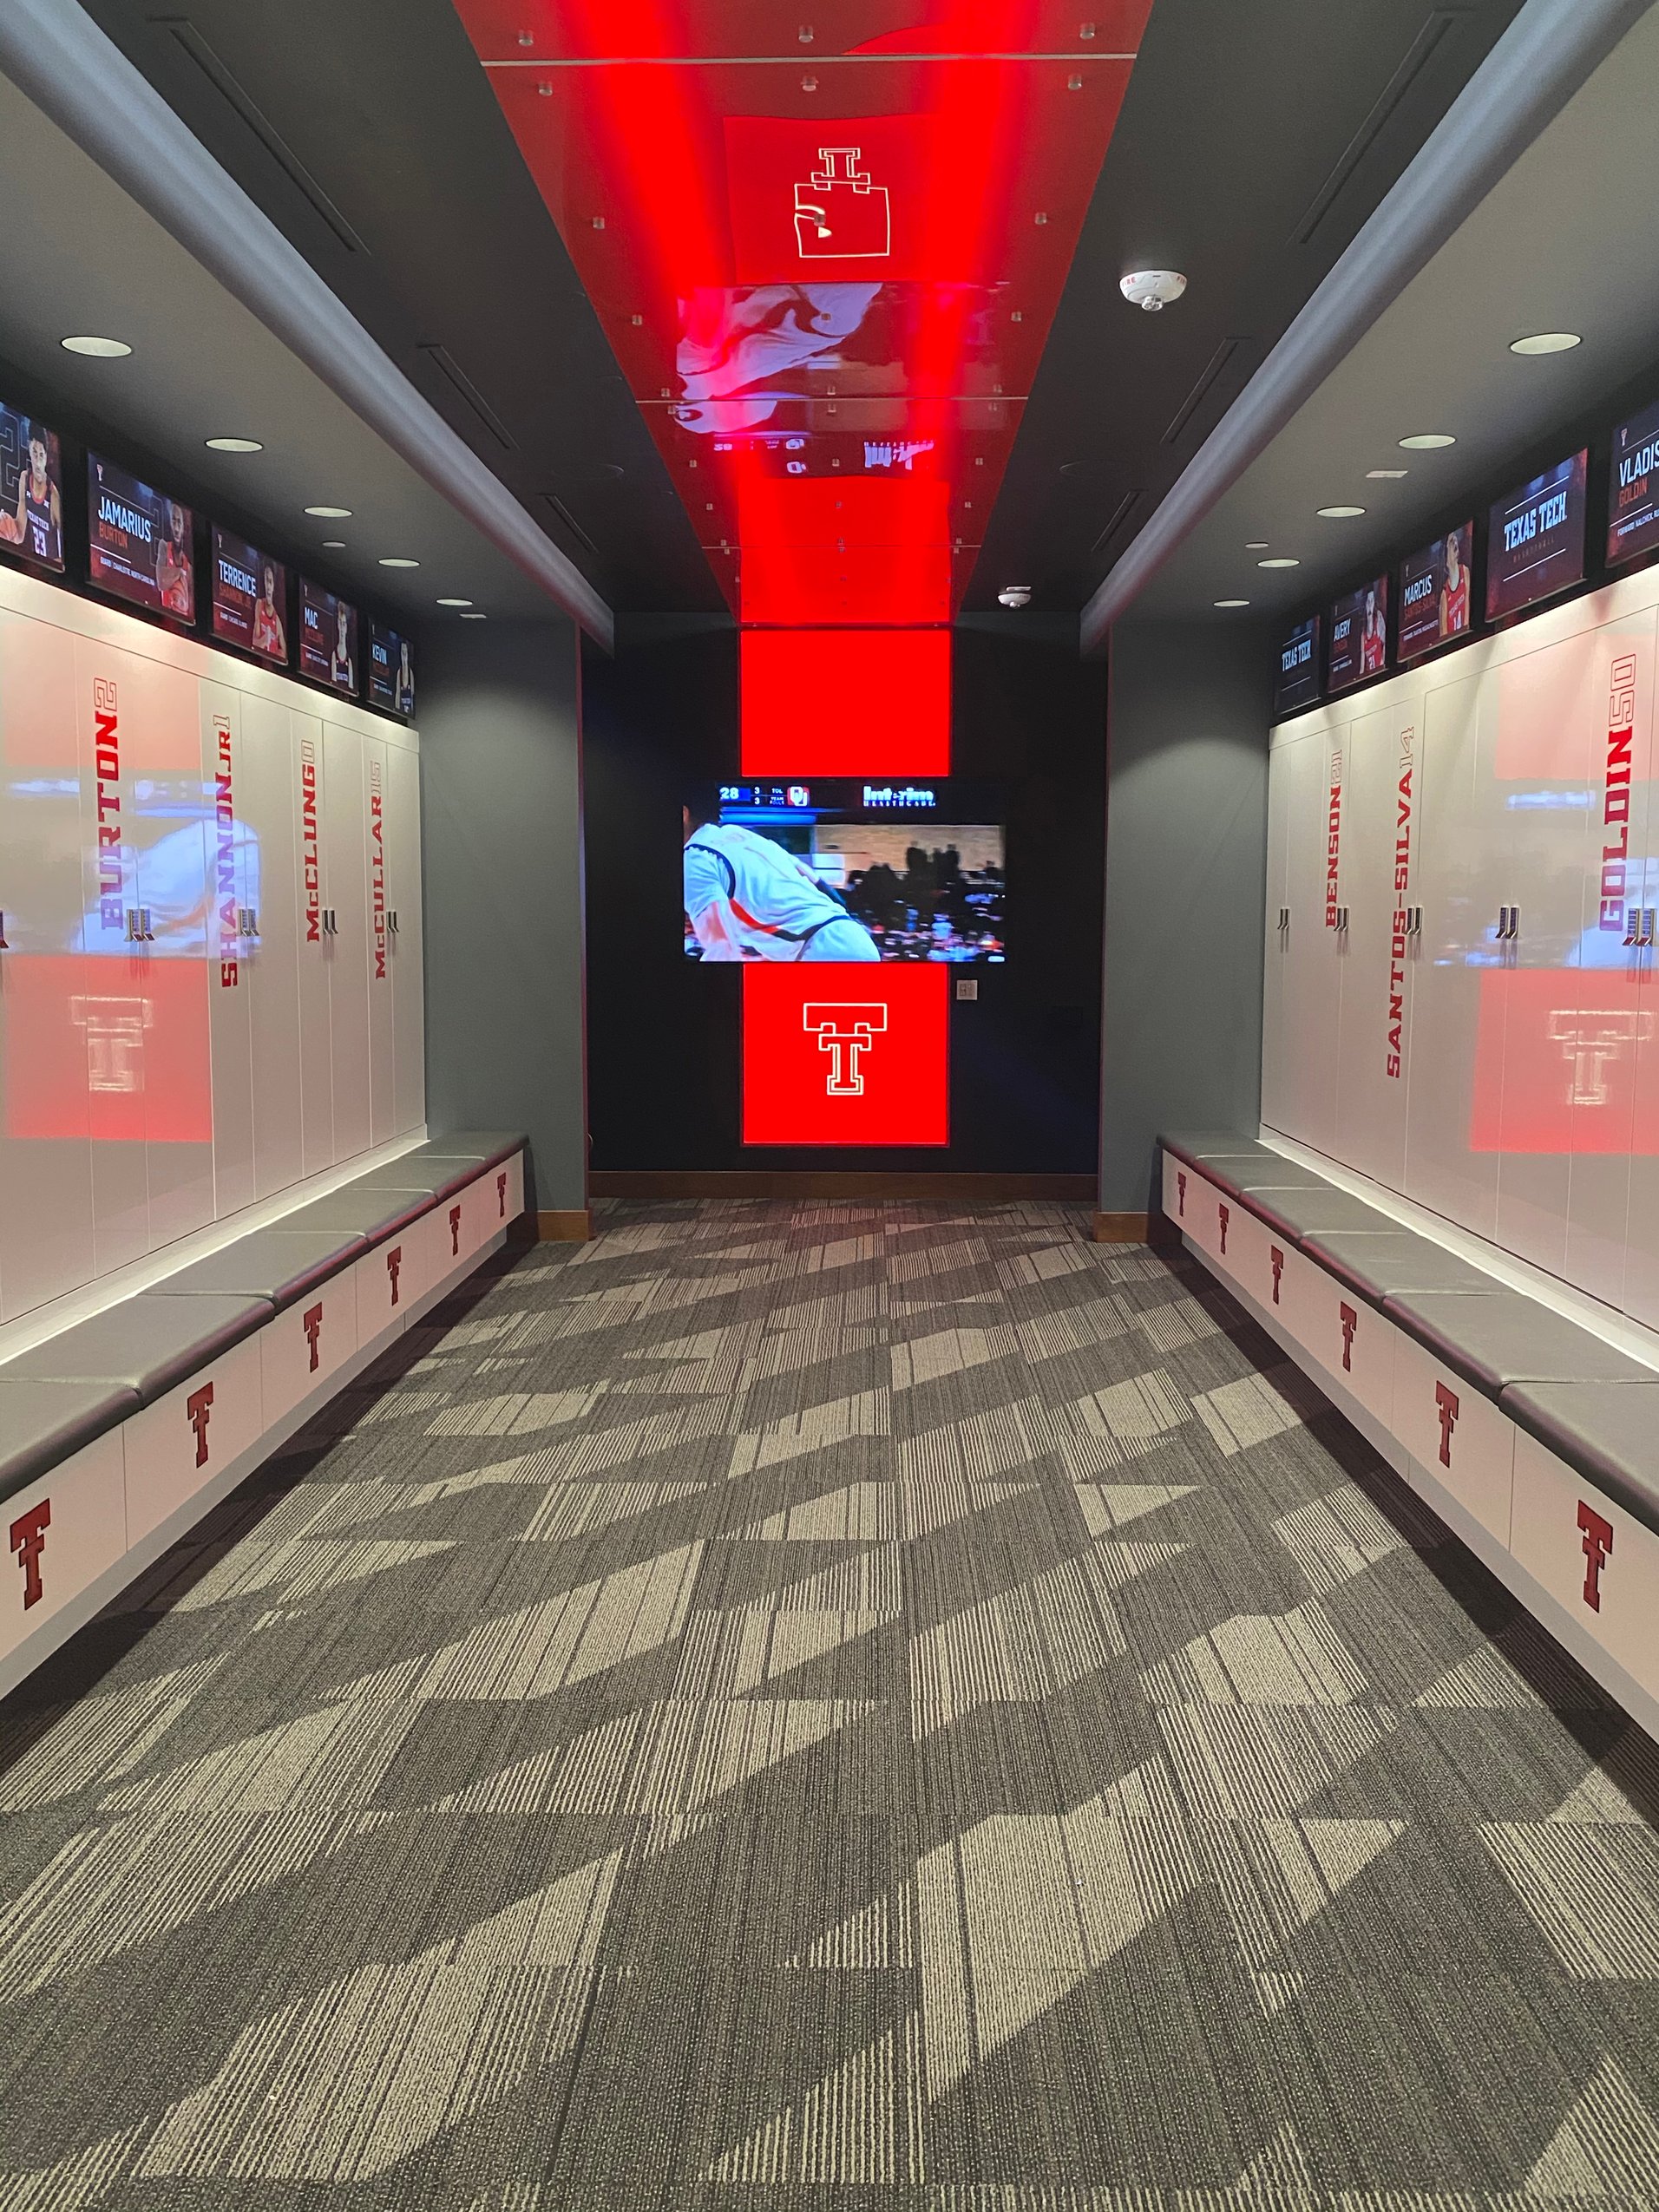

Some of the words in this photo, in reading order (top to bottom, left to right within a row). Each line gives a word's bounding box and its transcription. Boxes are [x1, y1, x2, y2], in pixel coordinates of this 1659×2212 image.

[1618, 477, 1649, 507] GOLDIN
[98, 495, 154, 543] JAMARIUS
[99, 521, 129, 549] BURTON
[1504, 507, 1537, 552] TEXAS
[1538, 490, 1568, 533] TECH
[219, 560, 257, 598] TERRENCE
[1404, 574, 1433, 606] MARCUS
[305, 607, 318, 630] MAC
[1334, 618, 1351, 642] AVERY
[372, 643, 388, 666] KEVIN
[1282, 646, 1298, 672] TEXAS
[720, 787, 739, 800] 28
[95, 710, 123, 930] BURTON
[1599, 725, 1633, 932] GOLDIN
[1325, 785, 1341, 928] BENSON
[1387, 769, 1413, 1079] SANTOS-SILVA
